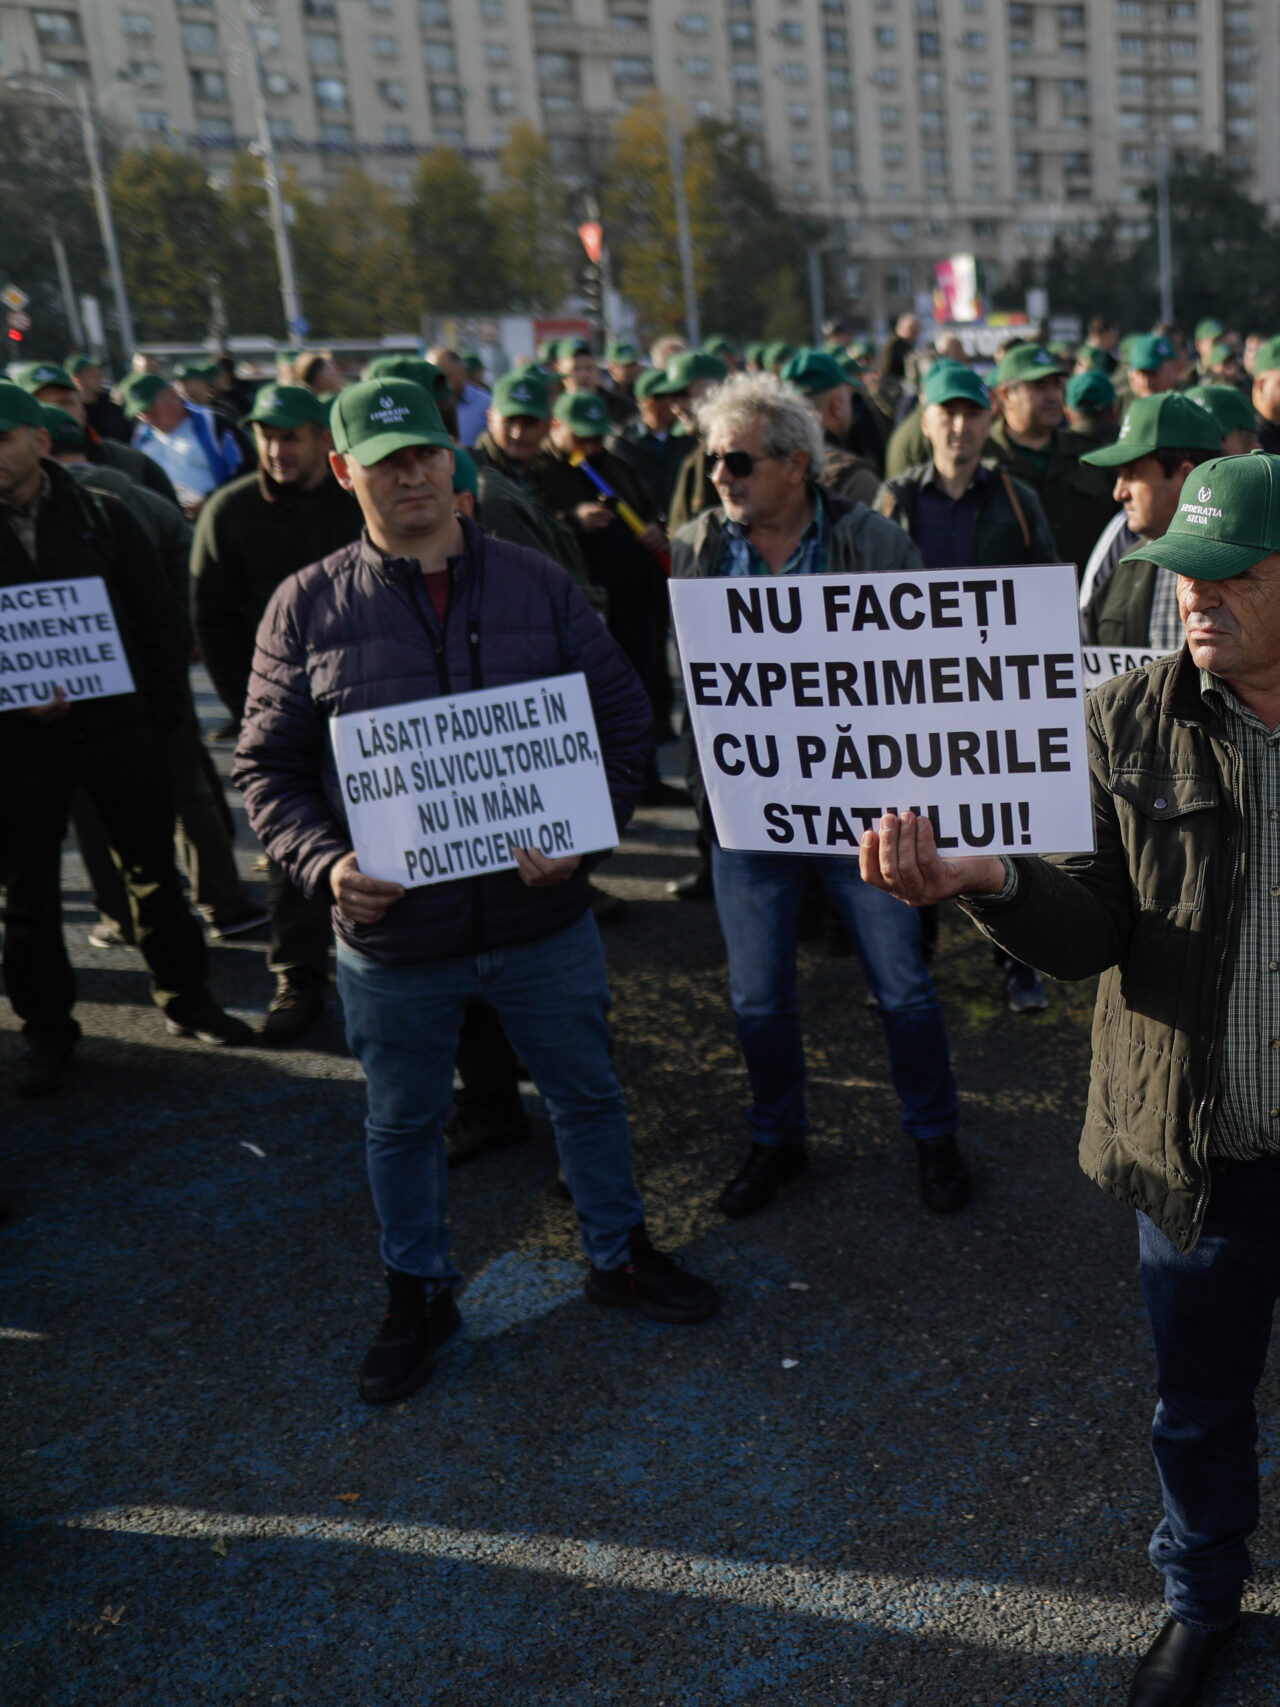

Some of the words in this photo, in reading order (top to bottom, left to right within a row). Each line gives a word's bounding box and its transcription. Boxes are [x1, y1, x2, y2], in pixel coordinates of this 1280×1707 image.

[1186, 514, 1208, 525] SILVA
[0, 585, 79, 612] ACEȚI
[726, 586, 802, 634] NU
[823, 579, 1017, 644] FACEȚI
[0, 613, 113, 643] RIMENTE
[0, 643, 117, 674] ĂDURILE
[689, 653, 1077, 707] EXPERIMENTE
[1083, 652, 1101, 675] U
[356, 717, 432, 761] LĂSAȚI
[435, 697, 541, 745] PĂDURILE
[540, 687, 568, 725] ÎN
[346, 765, 409, 803] GRIJA
[410, 731, 600, 793] SILVICULTORILOR,
[713, 733, 779, 778] CU
[796, 723, 1071, 780] PĂDURILE
[417, 799, 450, 835] NU
[452, 790, 479, 828] ÎN
[481, 782, 546, 823] MÂNA
[763, 801, 1031, 848] STATLUI!
